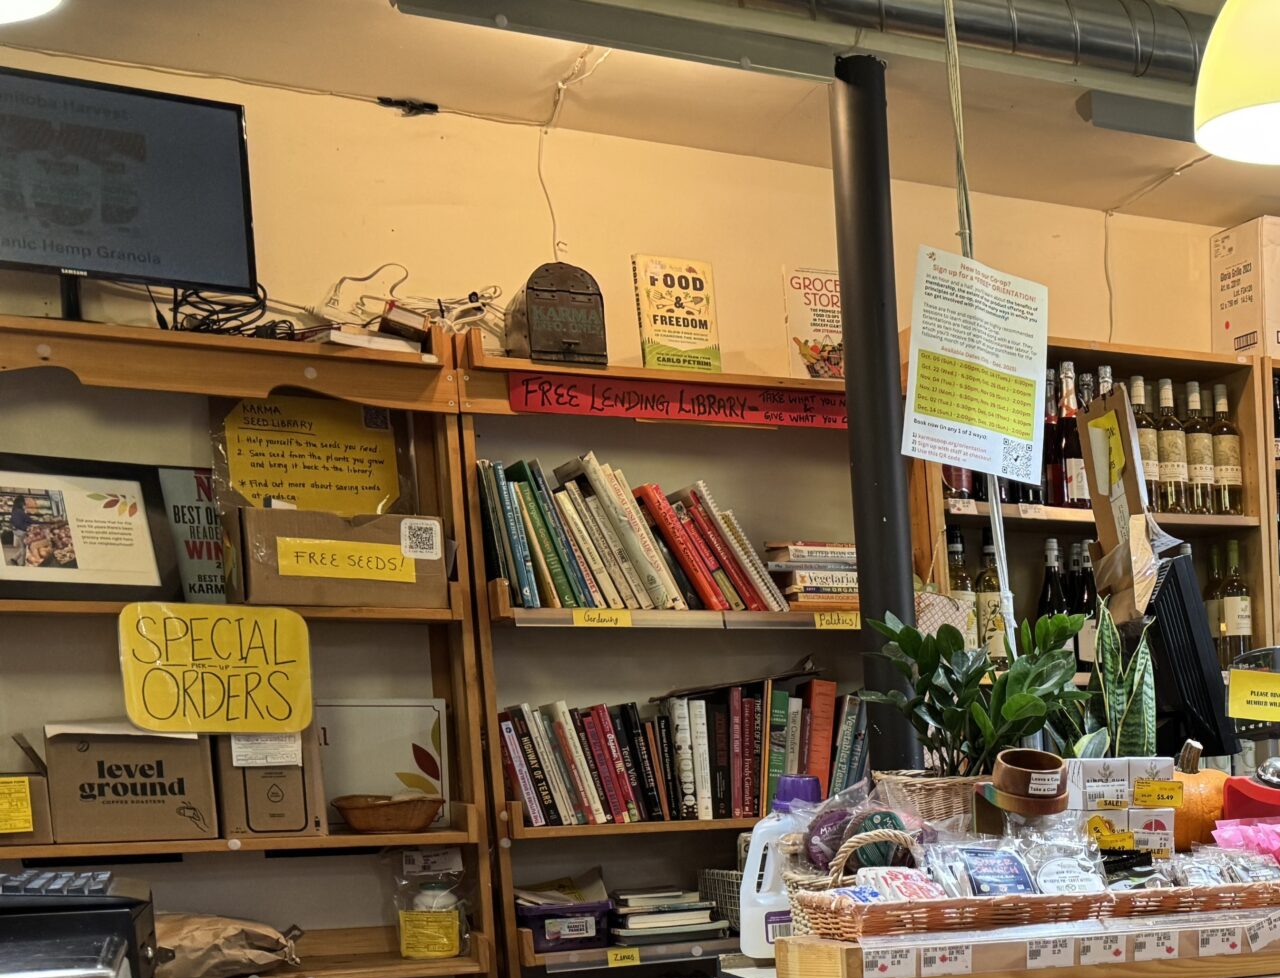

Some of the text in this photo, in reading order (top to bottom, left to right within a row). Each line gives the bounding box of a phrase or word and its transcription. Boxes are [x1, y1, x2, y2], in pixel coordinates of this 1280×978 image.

[42, 239, 162, 265] Hemp Granola
[649, 273, 704, 292] FOOD
[533, 305, 600, 321] KARMA
[653, 314, 709, 330] FREEDOM
[522, 376, 580, 407] FREE
[590, 380, 669, 413] LENDING
[242, 404, 281, 415] KARMA
[764, 411, 785, 422] GIVE
[789, 414, 816, 423] WHAT
[243, 417, 313, 430] SEED LIBRARY
[173, 506, 201, 525] BEST
[294, 551, 405, 573] FREE SEEDS!
[197, 575, 219, 583] BEST
[132, 616, 297, 666] SPECIAL
[142, 669, 293, 722] ORDERS
[1250, 690, 1268, 698] PLEASE
[832, 715, 857, 795] Vegetables Please
[97, 760, 164, 779] level
[521, 736, 552, 806] HIGHWAY OF TEARS
[621, 745, 638, 787] Terra Viva
[79, 778, 186, 801] ground
